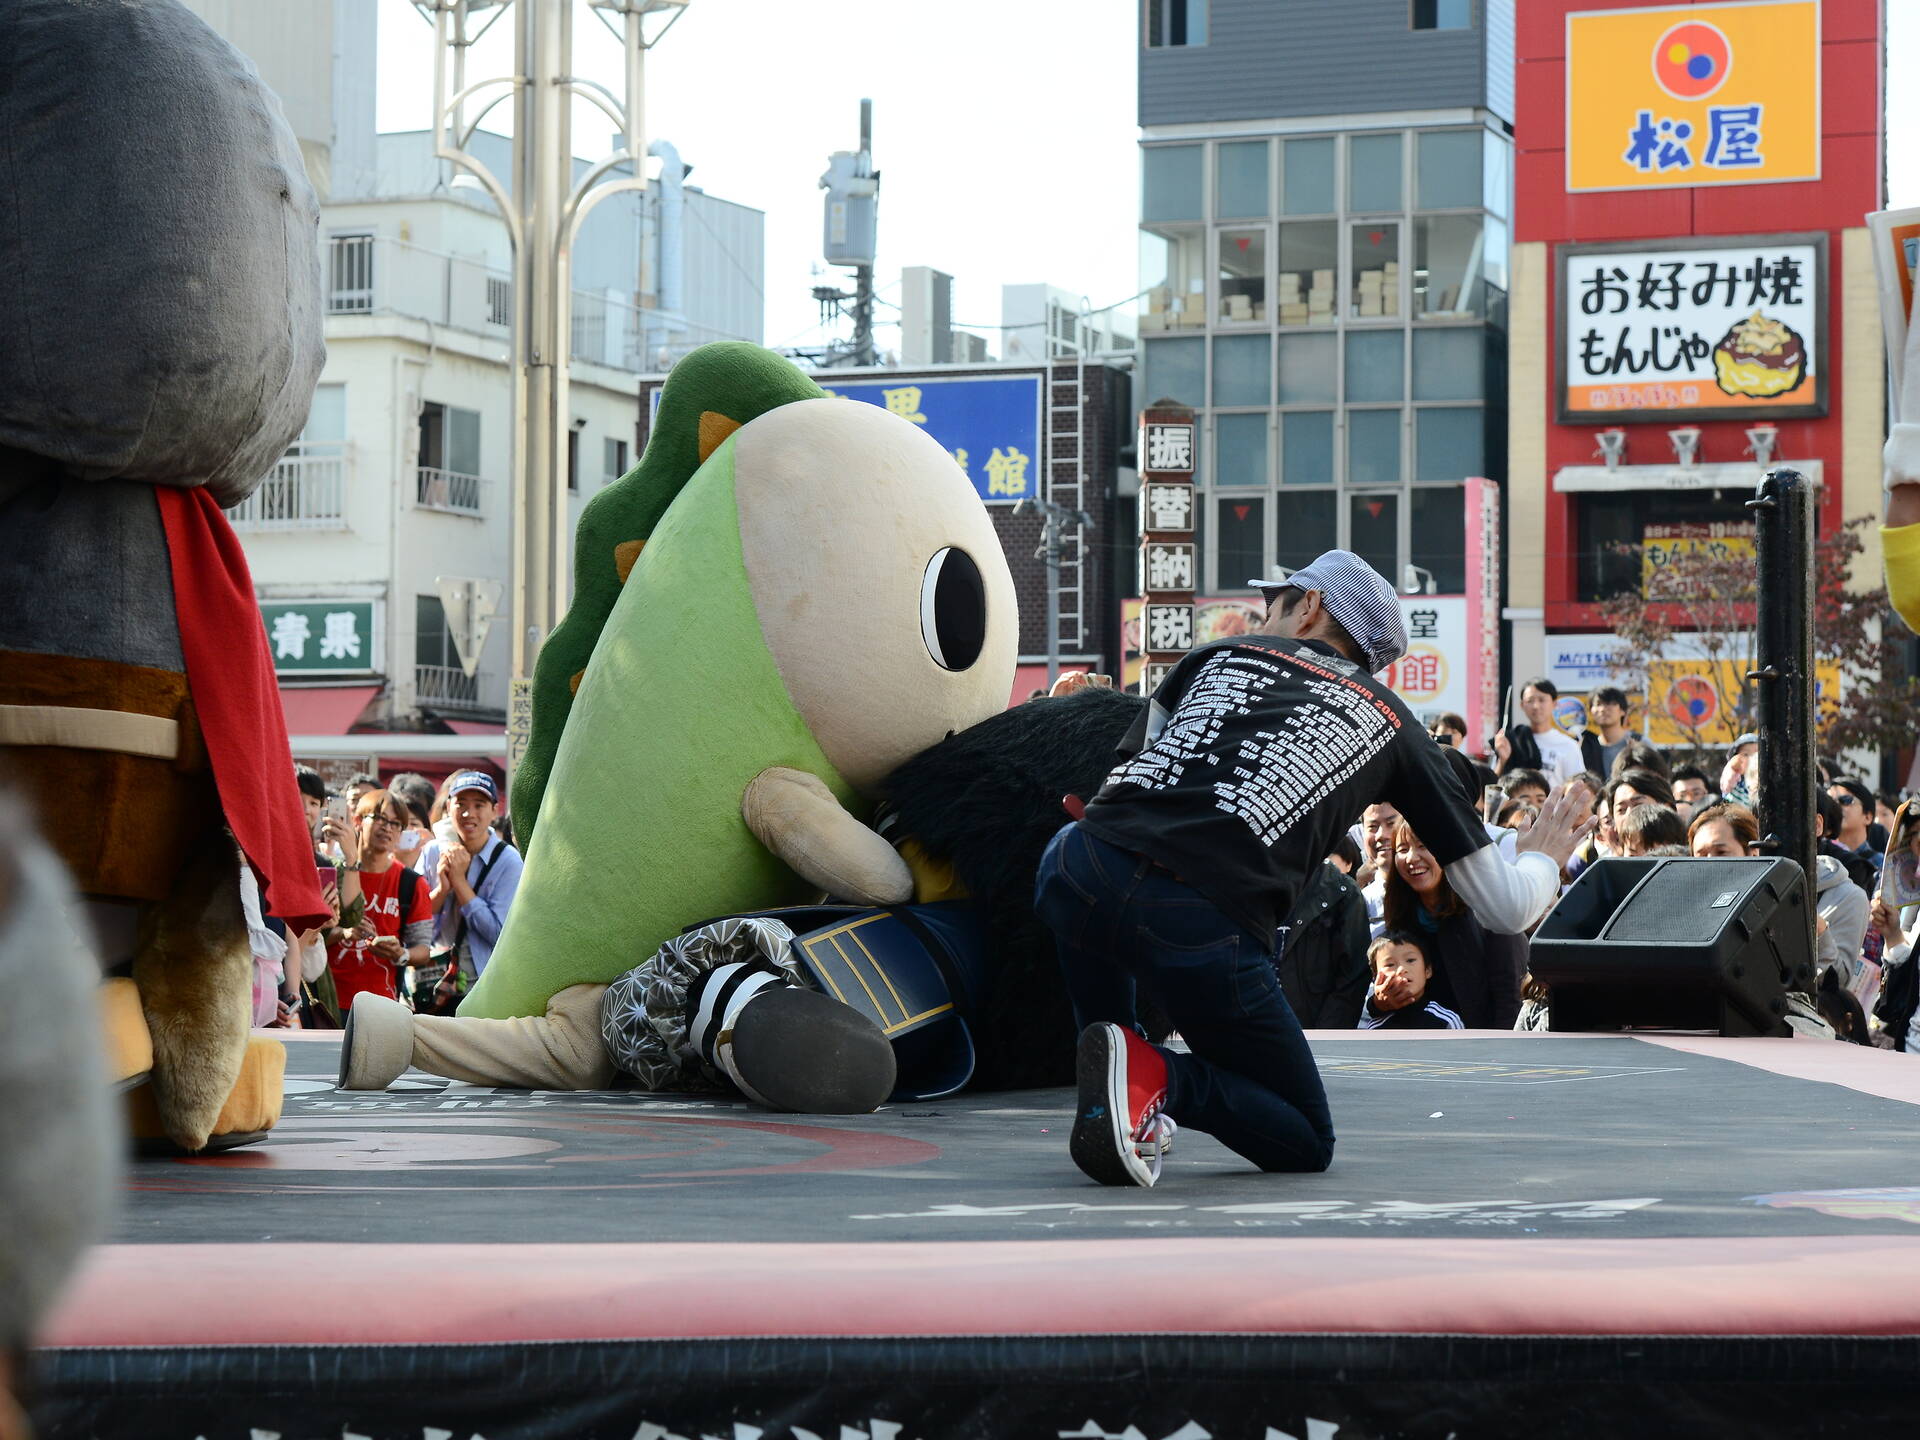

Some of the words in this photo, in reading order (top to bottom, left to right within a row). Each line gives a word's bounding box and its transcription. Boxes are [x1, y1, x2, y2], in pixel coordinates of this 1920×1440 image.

[1624, 105, 1764, 171] 松屋
[1580, 255, 1803, 315] お好み焼
[1579, 326, 1711, 376] もんじゃ
[270, 611, 362, 660] 青果
[1204, 674, 1251, 686] MILWAUKEE
[1253, 681, 1266, 690] WI
[1222, 667, 1260, 682] CHARLES
[1261, 677, 1276, 686] MO
[1226, 657, 1280, 674] INDIANAPOLIS
[1267, 649, 1338, 681] AMERICAN
[1340, 677, 1375, 701] TOUR
[1374, 699, 1402, 730] 2009
[1402, 654, 1439, 691] 館
[1237, 705, 1251, 716] NY
[1305, 703, 1321, 713] 1ST
[1321, 709, 1365, 749] MARYSVILLE
[1363, 749, 1373, 762] CA
[1328, 687, 1360, 705] CORPUS
[1358, 702, 1384, 731] CHRISTI
[1383, 730, 1393, 743] TX
[1334, 695, 1356, 709] PASO
[1354, 707, 1379, 734] ROBLES
[1377, 735, 1387, 748] CA
[1343, 688, 1361, 700] SAN
[1359, 698, 1387, 725] ANTONIO
[1387, 725, 1397, 739] TX
[1344, 707, 1375, 739] CONCORD
[1265, 742, 1286, 755] 11TH
[1285, 751, 1322, 786] MORRISON
[1276, 738, 1328, 778] ALBUQUERQUE
[1295, 729, 1313, 742] 7TH
[1311, 739, 1342, 769] PHOENIX
[1339, 769, 1350, 781] AZ
[1296, 739, 1314, 753] LAS
[1312, 749, 1335, 773] VEGAS
[1332, 773, 1344, 786] NV
[1299, 714, 1317, 727] 4TH
[1317, 724, 1336, 739] SAN
[1332, 735, 1354, 758] DIEGO
[1352, 758, 1362, 772] CA
[1304, 725, 1330, 745] COSTA
[1327, 741, 1348, 763] MESA
[1346, 763, 1356, 777] CA
[1312, 713, 1330, 726] LOS
[1328, 722, 1360, 753] ANGELES
[1357, 754, 1368, 767] CA
[1356, 727, 1377, 756] AUGUST
[1233, 766, 1254, 780] 17TH
[1252, 774, 1295, 811] HOLLYWOOD
[1292, 809, 1303, 823] FL
[1238, 748, 1259, 760] 15TH
[1258, 757, 1273, 767] ST
[1270, 762, 1310, 798] AUGUSTINE
[1306, 796, 1317, 809] FL
[1261, 749, 1290, 767] GRAND
[1286, 763, 1315, 791] PRAIRIE
[1313, 790, 1323, 803] TX
[1278, 780, 1302, 805] TAMPA
[1299, 802, 1311, 815] FL
[1214, 787, 1238, 801] 22ND
[1236, 797, 1271, 829] COLUMBIA
[1215, 799, 1238, 814] 23RD
[1237, 807, 1264, 836] GILFORD
[1235, 787, 1280, 824] ALPHARETTA
[1260, 789, 1288, 817] ESTERO
[1284, 815, 1295, 829] FL
